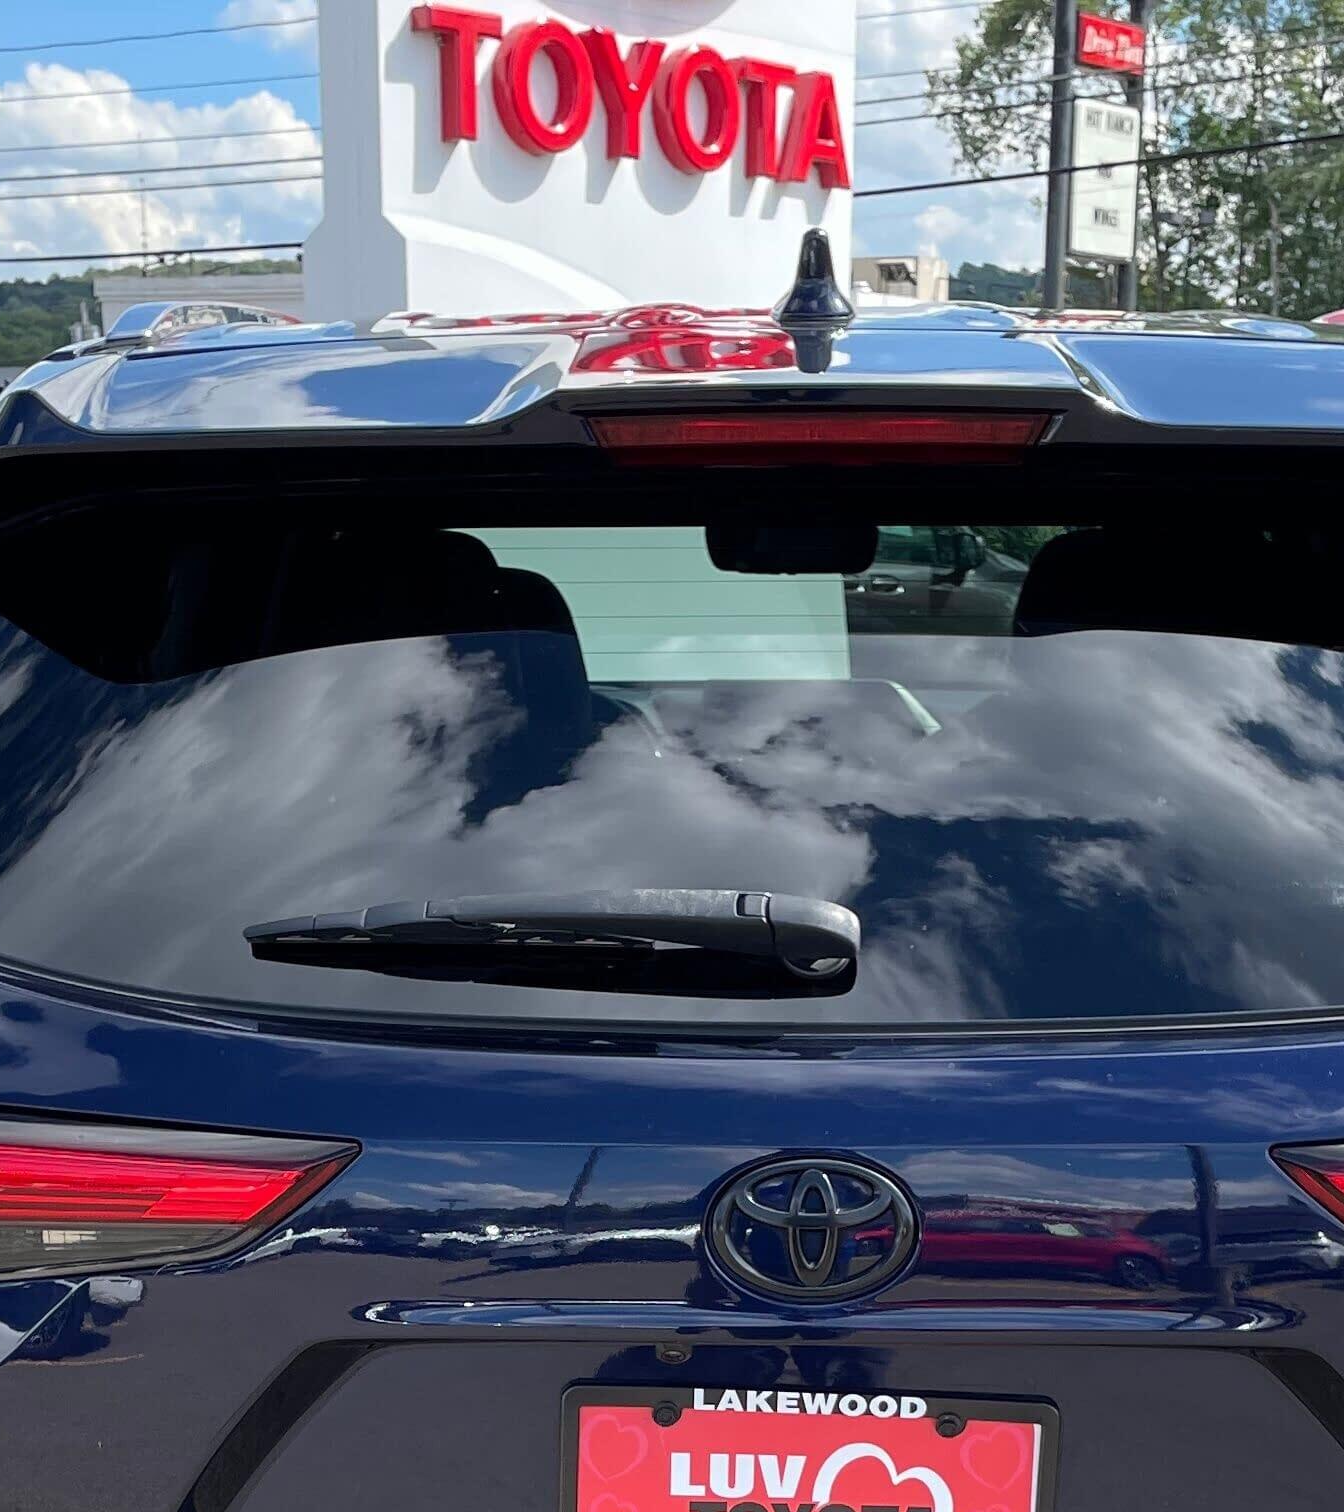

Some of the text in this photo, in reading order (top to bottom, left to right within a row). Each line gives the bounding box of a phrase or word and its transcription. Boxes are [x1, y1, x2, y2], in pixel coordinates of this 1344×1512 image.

[412, 4, 851, 190] TOYOTA
[693, 1387, 927, 1420] LAKEWOOD
[669, 1453, 806, 1499] LUV
